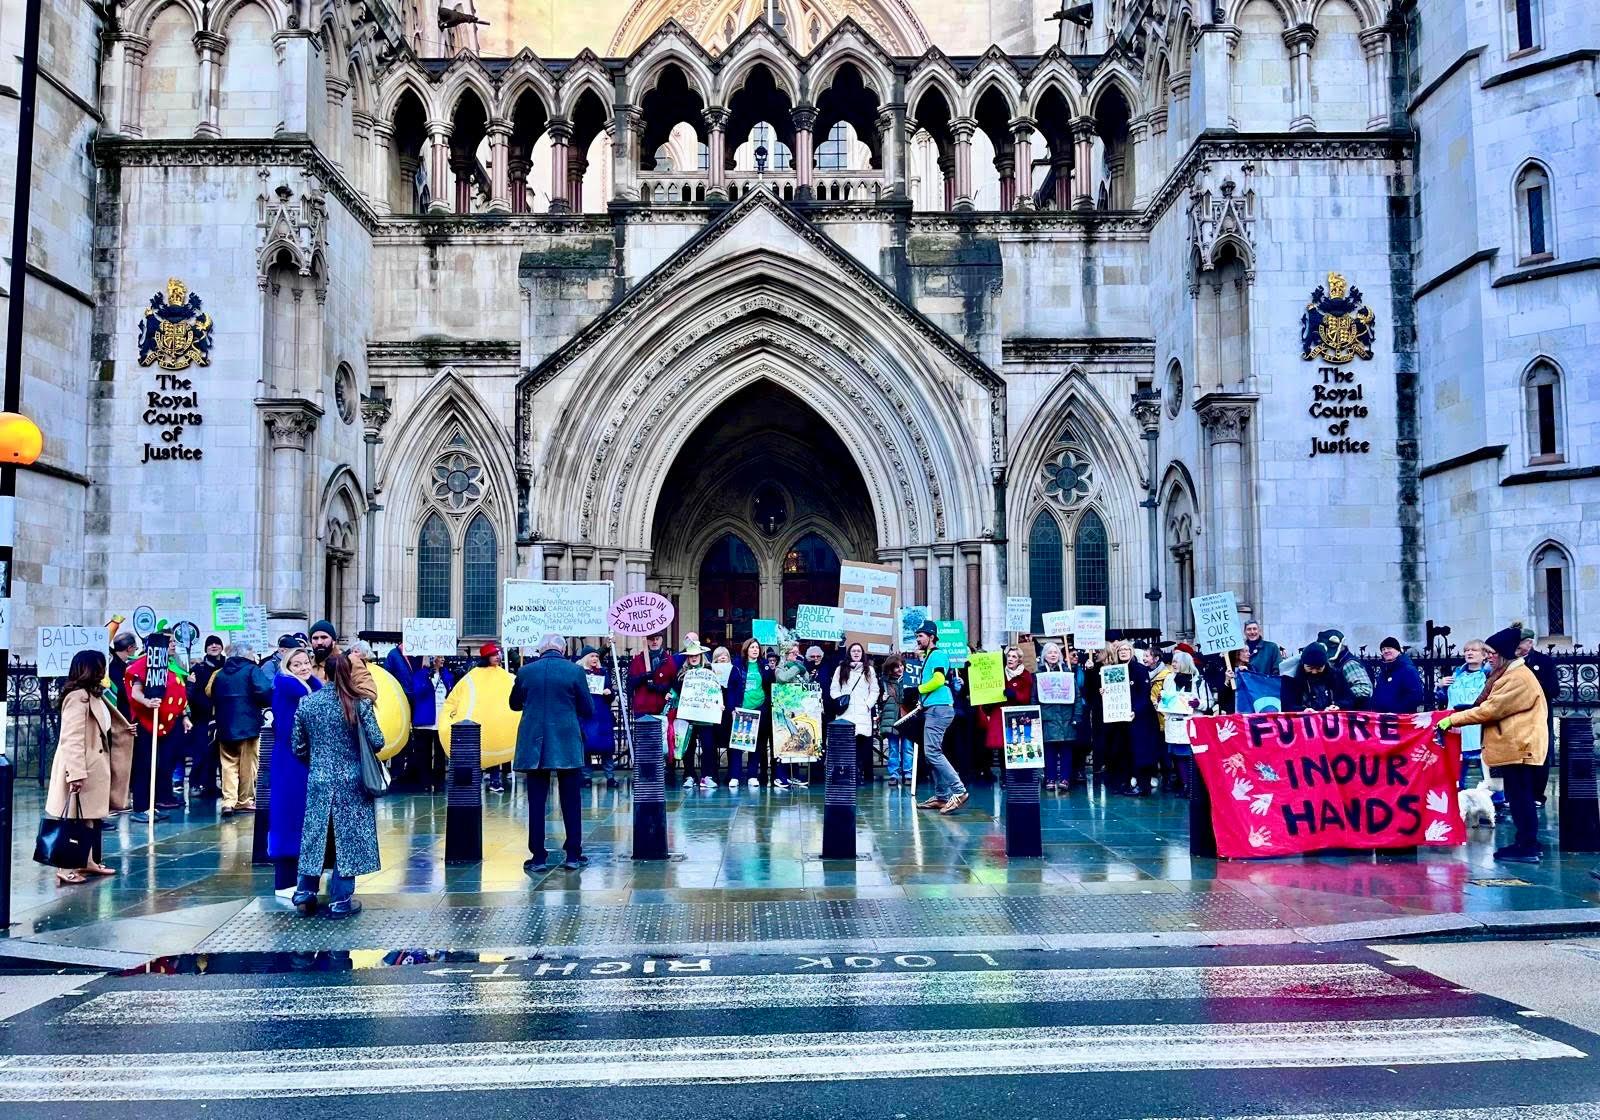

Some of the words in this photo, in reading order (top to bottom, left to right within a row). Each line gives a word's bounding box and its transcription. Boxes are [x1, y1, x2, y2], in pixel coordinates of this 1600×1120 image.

[156, 374, 192, 391] The
[1319, 367, 1354, 383] The
[147, 392, 198, 410] Royal
[1313, 384, 1363, 403] Royal
[143, 409, 203, 426] Courts
[1309, 402, 1368, 418] Courts
[161, 426, 183, 443] of
[1328, 419, 1350, 436] of
[141, 443, 203, 464] Justice
[1309, 437, 1370, 458] Justice
[611, 598, 633, 618] LAND
[634, 595, 656, 606] HELD
[656, 601, 667, 611] IN
[627, 609, 652, 621] TRUST
[798, 606, 831, 615] VANITY
[405, 618, 424, 631] ACE
[504, 615, 520, 627] LAND
[613, 619, 630, 632] FOR
[631, 624, 647, 632] ALL
[646, 620, 656, 630] OF
[656, 614, 667, 625] US
[796, 621, 810, 630] OR
[797, 613, 835, 624] PROJECT
[1202, 609, 1230, 625] SAVE
[42, 628, 89, 648] BALLS
[94, 631, 103, 641] to
[1208, 623, 1229, 637] OUR
[404, 634, 428, 652] SAVE
[435, 634, 455, 649] PARK
[1207, 635, 1237, 651] TREES
[802, 682, 821, 692] STOP
[1106, 684, 1126, 694] GREEN
[1247, 713, 1401, 748] FUTURE
[1282, 795, 1422, 836] HANDS
[471, 959, 711, 978] RIGHT
[794, 953, 999, 969] LOOK
